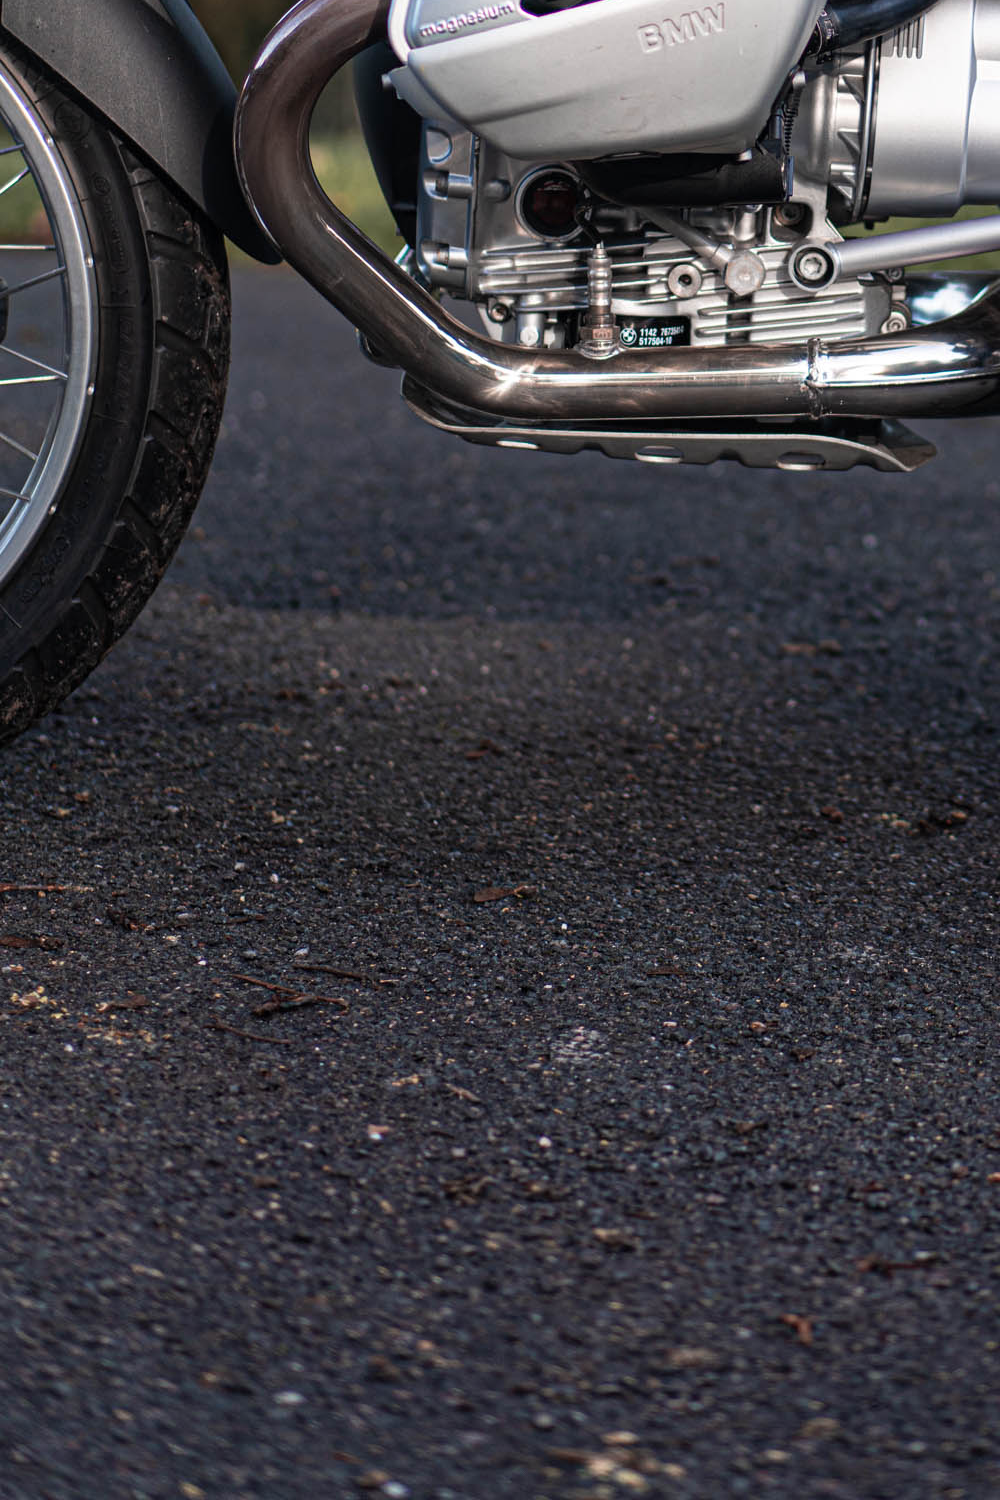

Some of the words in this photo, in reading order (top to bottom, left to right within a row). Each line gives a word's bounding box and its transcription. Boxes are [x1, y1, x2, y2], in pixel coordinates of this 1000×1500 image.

[420, 0, 515, 36] magnesium
[637, 2, 725, 54] BMW
[640, 328, 657, 336] 1142
